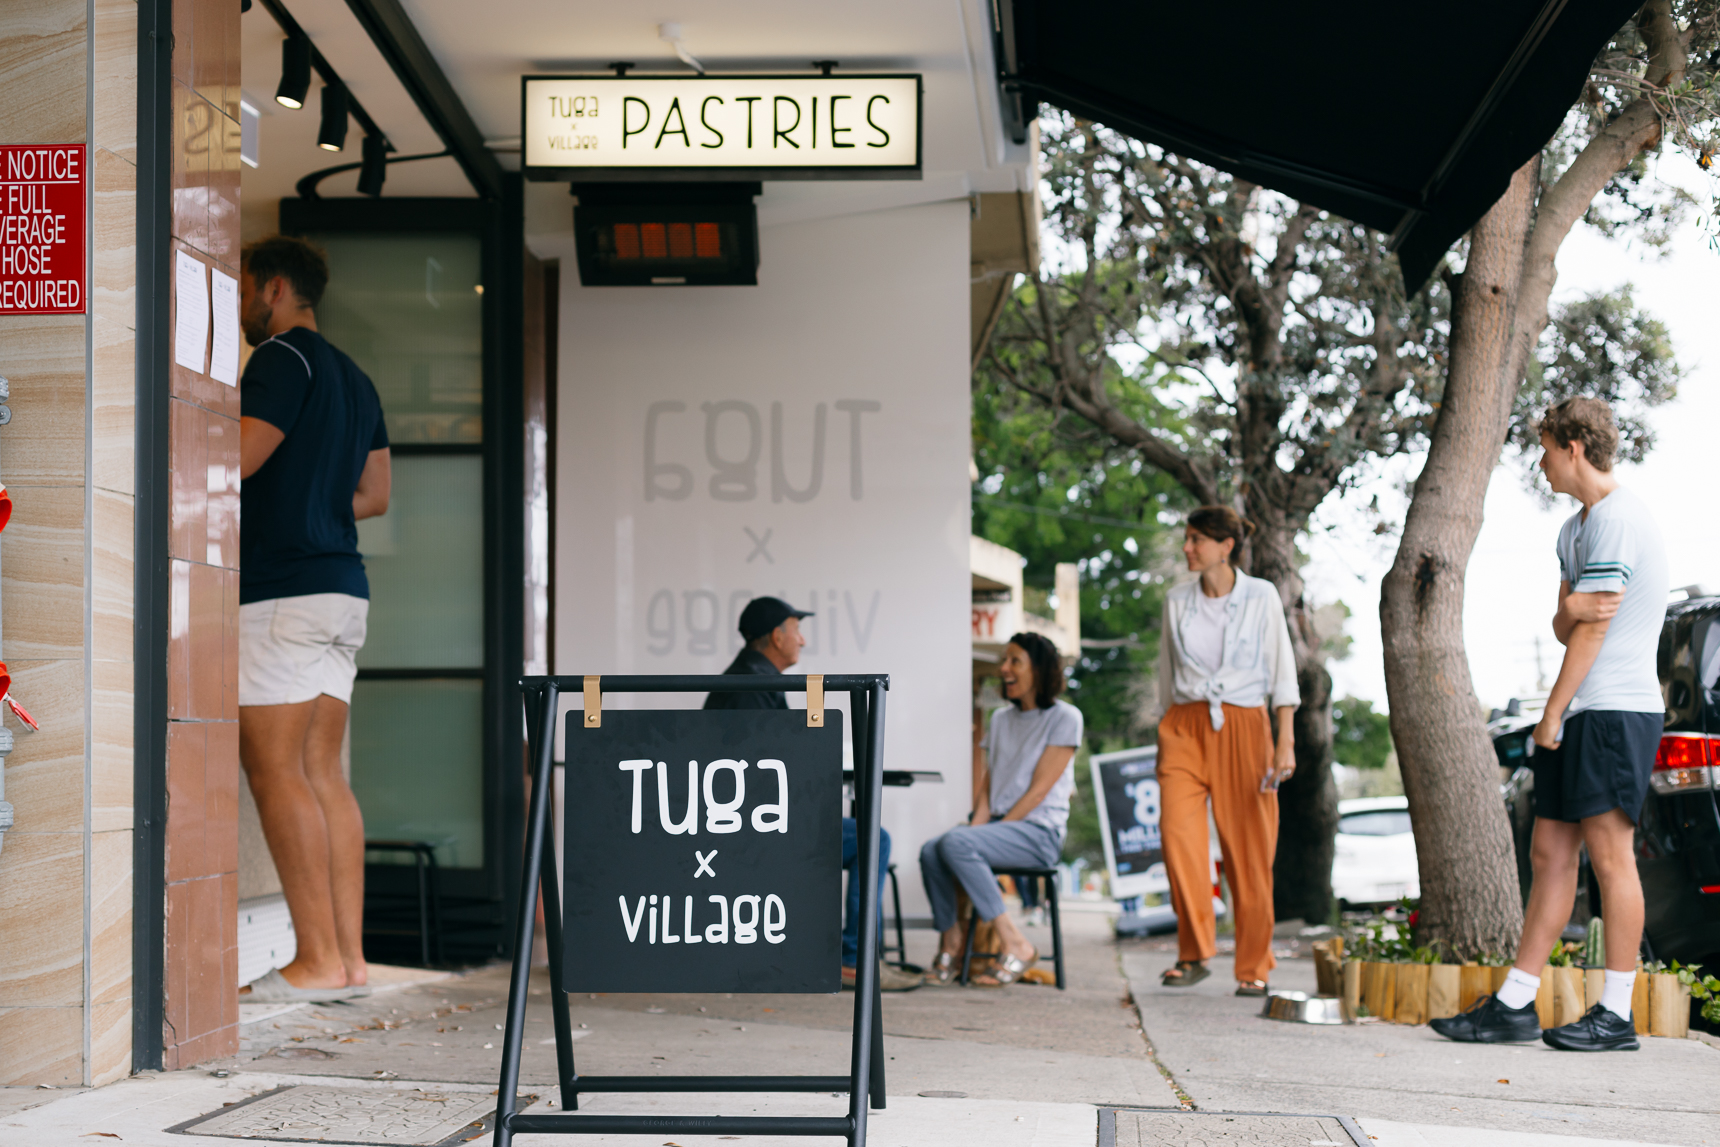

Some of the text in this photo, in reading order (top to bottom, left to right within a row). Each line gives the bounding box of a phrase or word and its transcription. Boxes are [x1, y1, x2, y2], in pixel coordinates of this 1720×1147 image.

[622, 95, 890, 149] PASTRIES
[8, 149, 79, 180] NOTICE
[8, 184, 52, 214] FULL
[2, 245, 52, 275] HOSE
